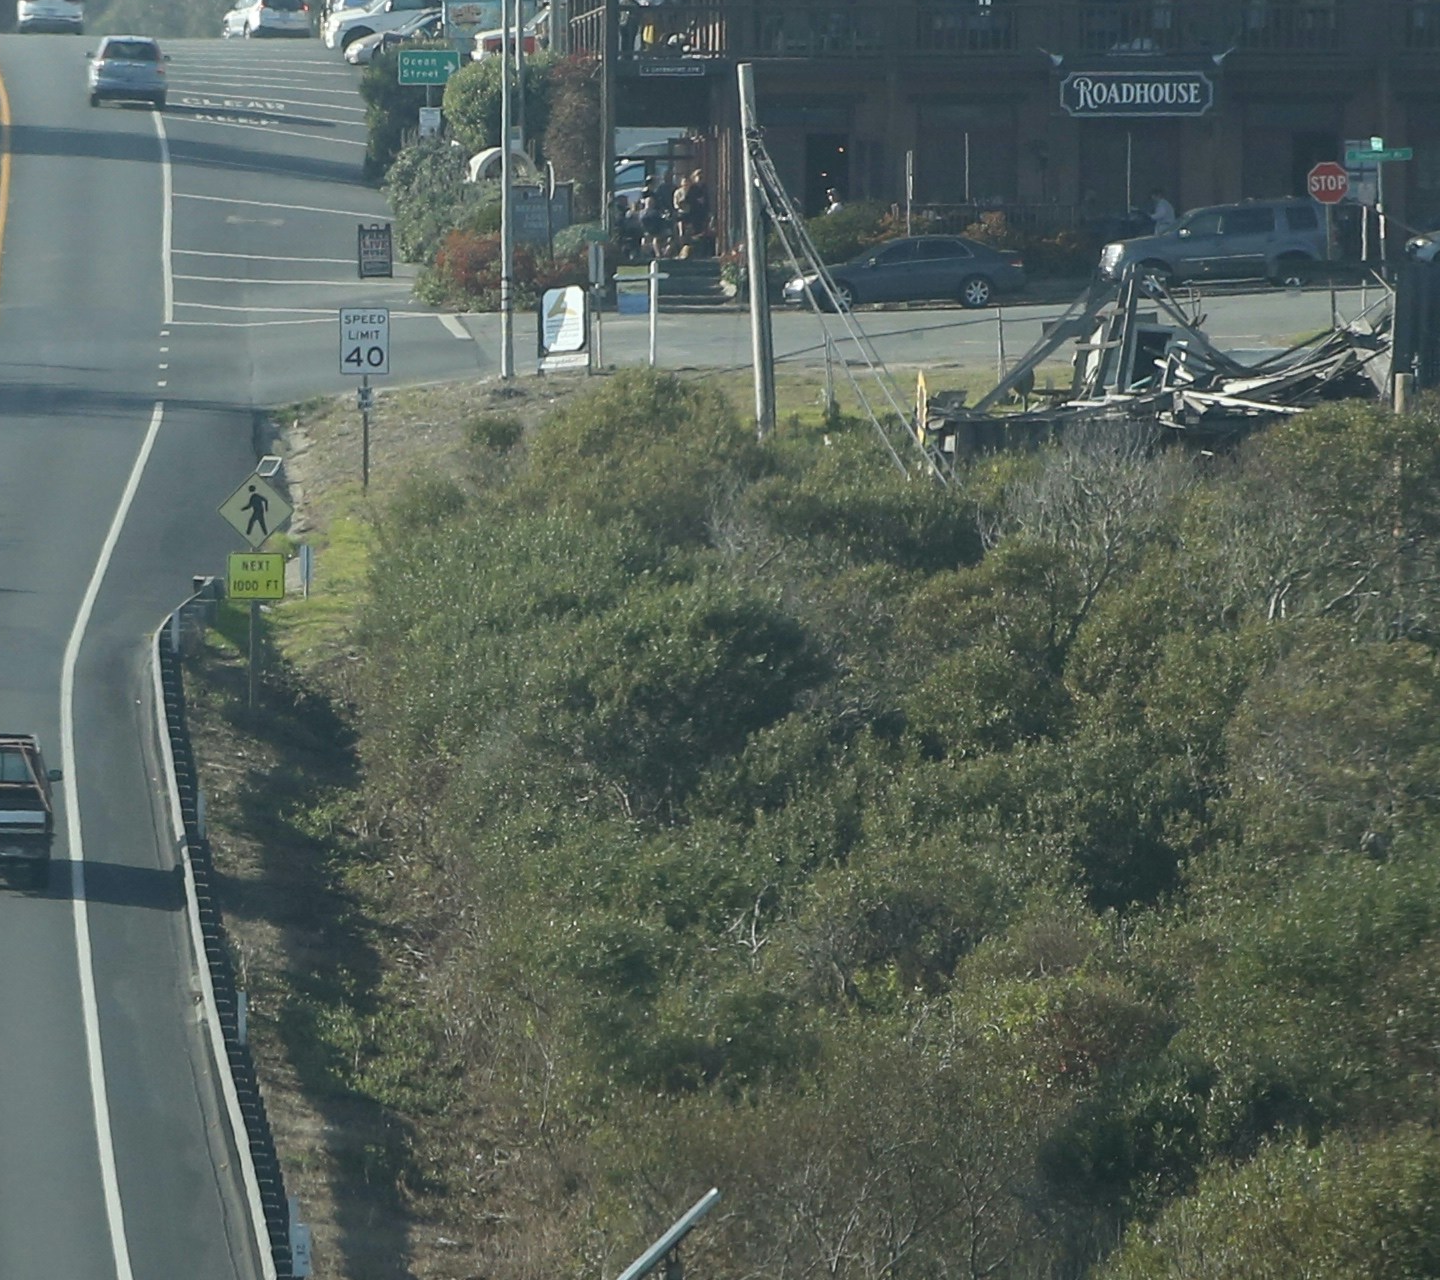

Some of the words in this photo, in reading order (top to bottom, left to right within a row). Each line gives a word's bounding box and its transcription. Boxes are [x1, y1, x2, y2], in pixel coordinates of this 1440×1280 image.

[402, 56, 437, 66] Ocean
[402, 68, 439, 78] Street
[1072, 76, 1202, 111] ROADHOUSE
[182, 97, 286, 111] CLEAR
[1310, 175, 1346, 192] STOP
[344, 314, 386, 325] SPEED
[348, 330, 380, 340] LIMIT
[344, 345, 385, 367] 40
[241, 560, 271, 571] NEXT
[233, 579, 259, 592] 1000
[266, 579, 280, 591] FT
